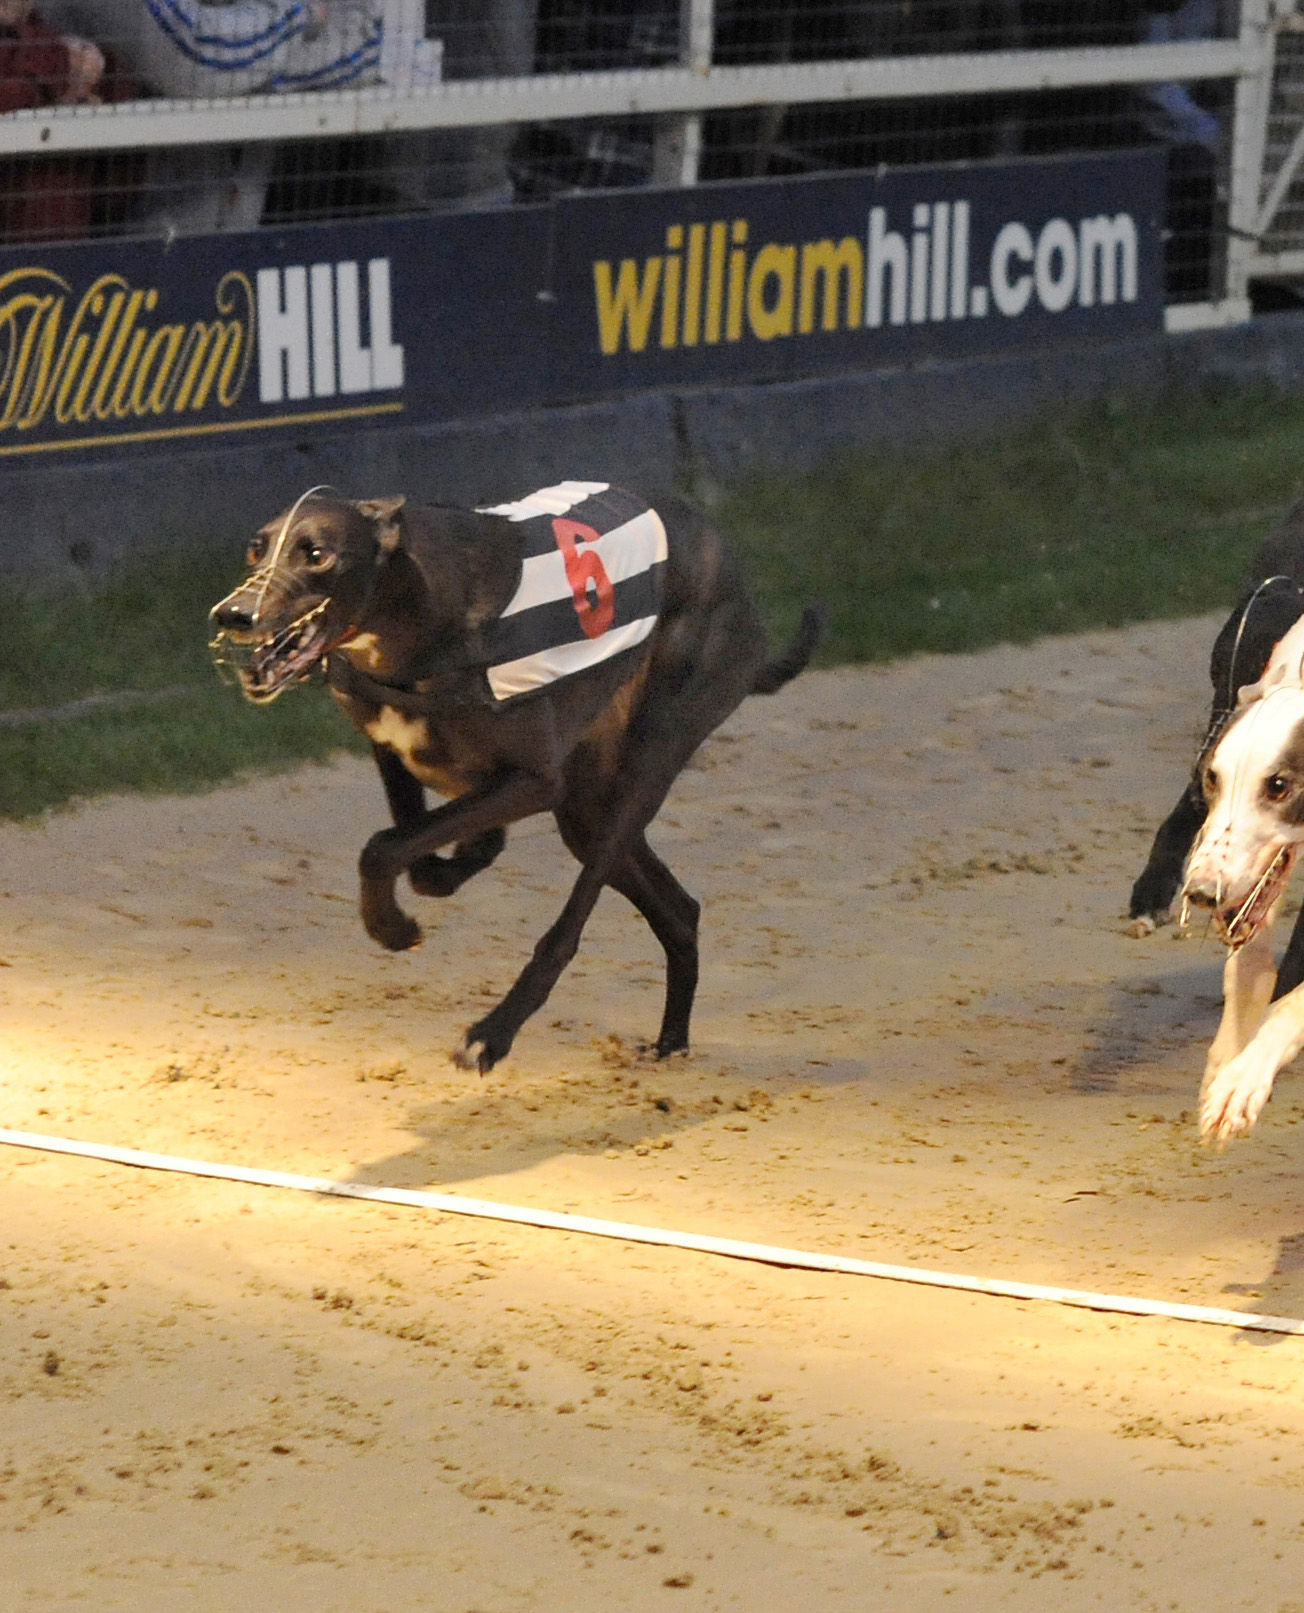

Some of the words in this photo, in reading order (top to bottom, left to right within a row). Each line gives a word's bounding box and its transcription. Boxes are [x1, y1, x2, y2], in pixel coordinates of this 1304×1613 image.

[0, 266, 256, 430] William
[257, 258, 404, 403] HILL
[593, 200, 1139, 356] williamhill.com
[551, 517, 616, 640] 6
